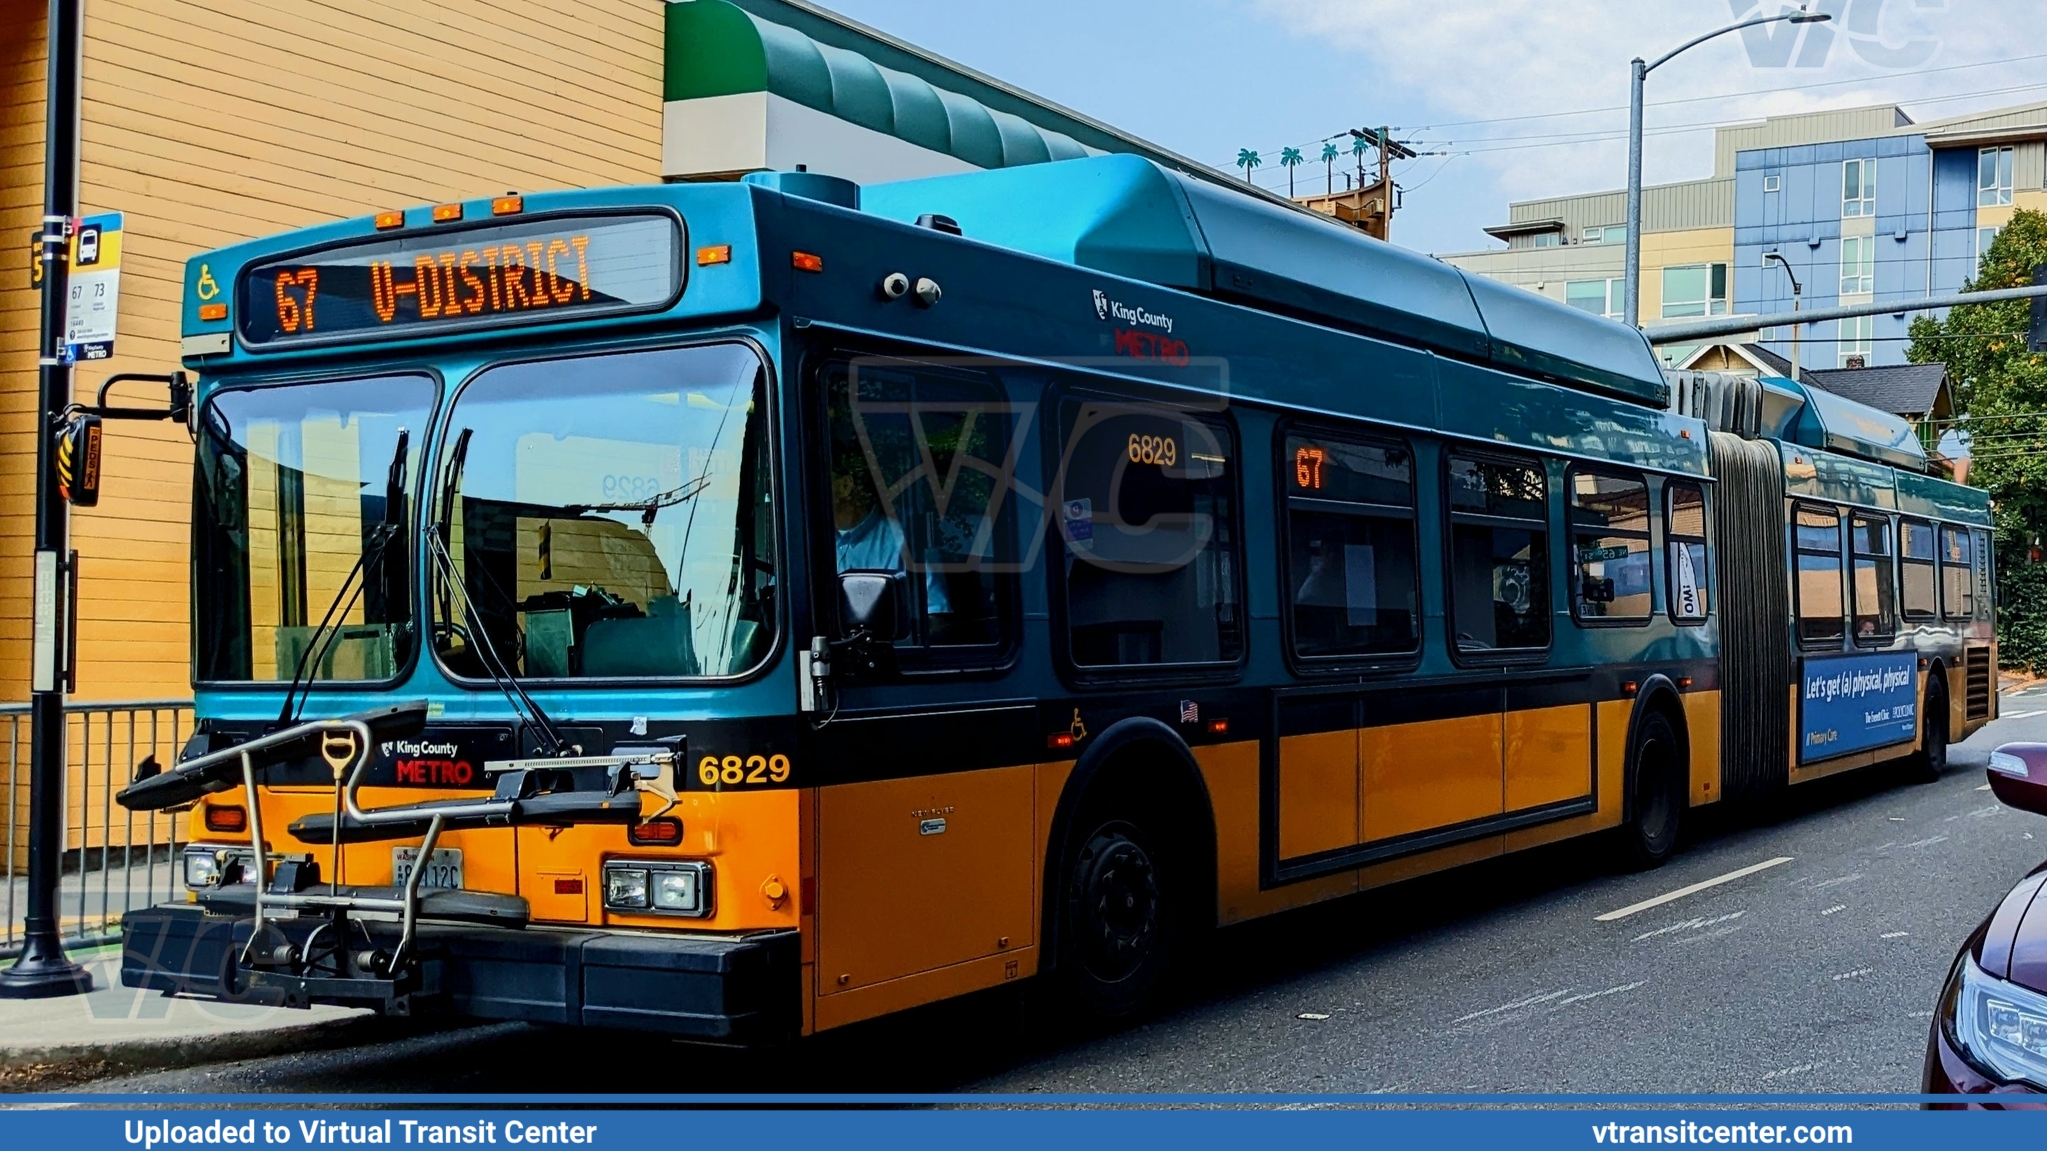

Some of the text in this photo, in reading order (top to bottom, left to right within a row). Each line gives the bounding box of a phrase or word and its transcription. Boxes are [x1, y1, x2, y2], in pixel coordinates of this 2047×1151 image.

[33, 255, 43, 282] 5
[275, 235, 590, 333] 67 U-DISTRICT
[72, 286, 82, 299] 67
[94, 283, 105, 297] 73
[1111, 301, 1173, 333] King County
[1114, 327, 1189, 367] METRO
[88, 435, 98, 469] PEDS
[1128, 433, 1176, 466] 6829
[1296, 447, 1322, 489] 67
[1806, 665, 1910, 702] Let's get (a) physical, physical
[397, 740, 458, 758] King County
[1810, 728, 1838, 746] Primary Care
[397, 760, 473, 784] METRO
[699, 754, 790, 785] 6829
